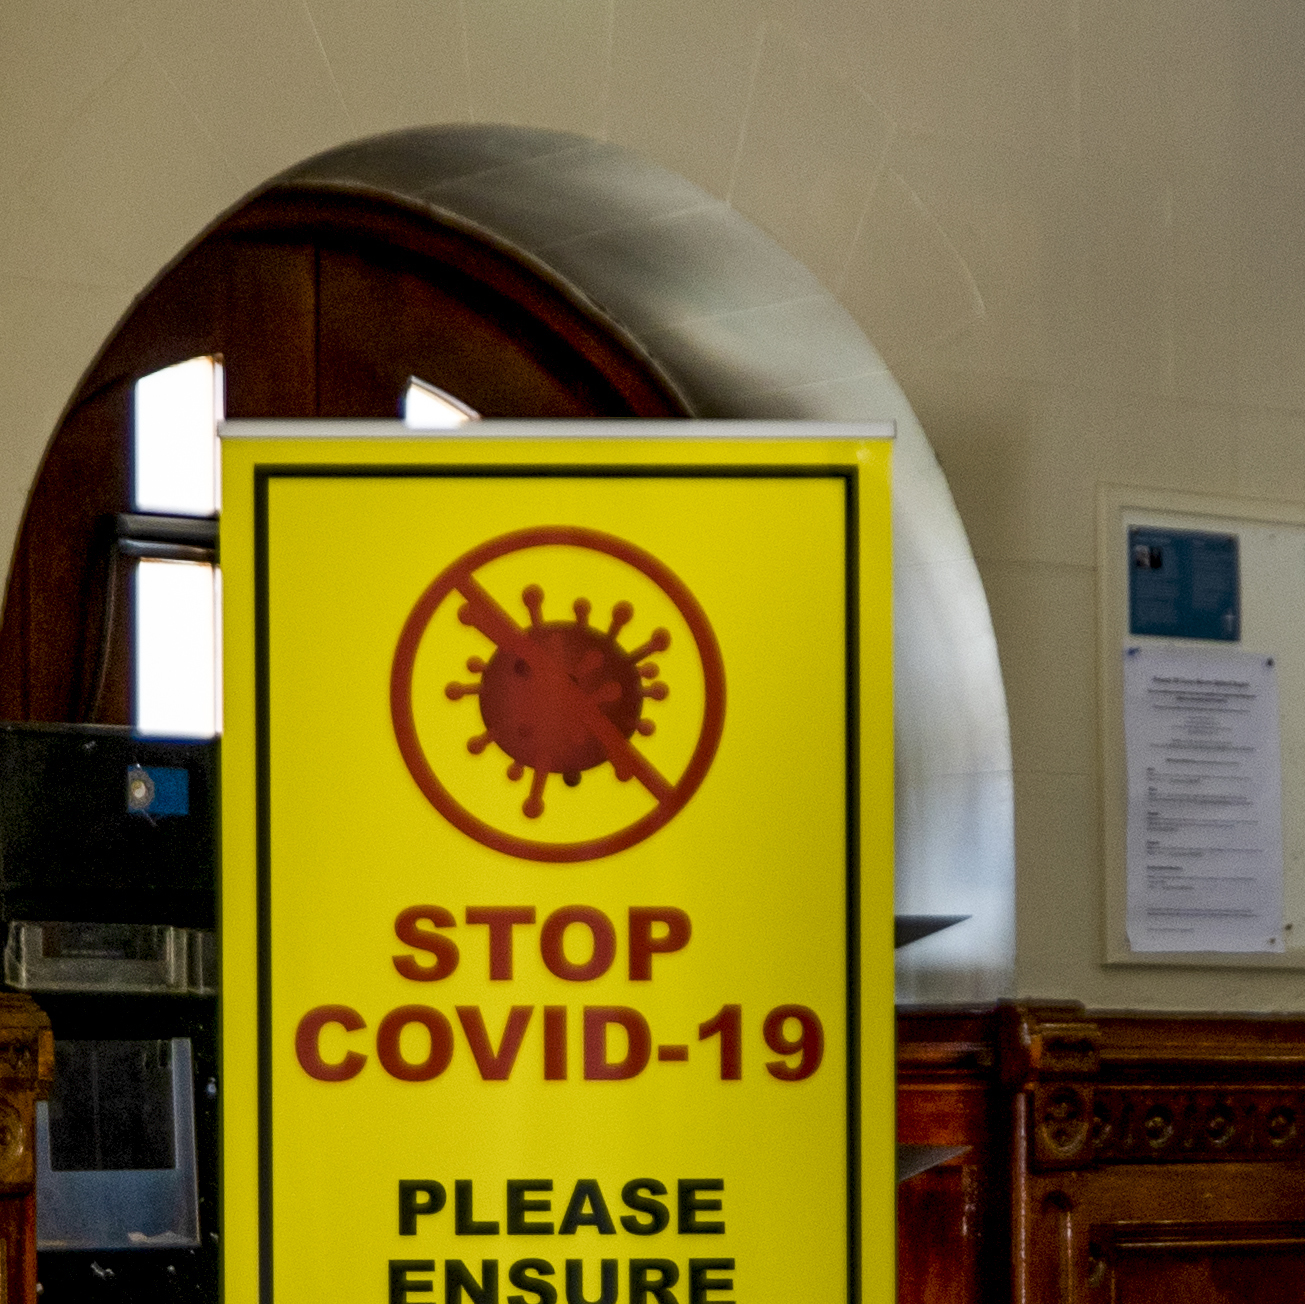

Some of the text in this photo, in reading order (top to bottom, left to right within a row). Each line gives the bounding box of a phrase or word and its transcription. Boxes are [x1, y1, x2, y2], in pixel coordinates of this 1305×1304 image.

[392, 905, 692, 983] STOP
[295, 1004, 825, 1083] COVID-19
[399, 1178, 725, 1236] PLEASE
